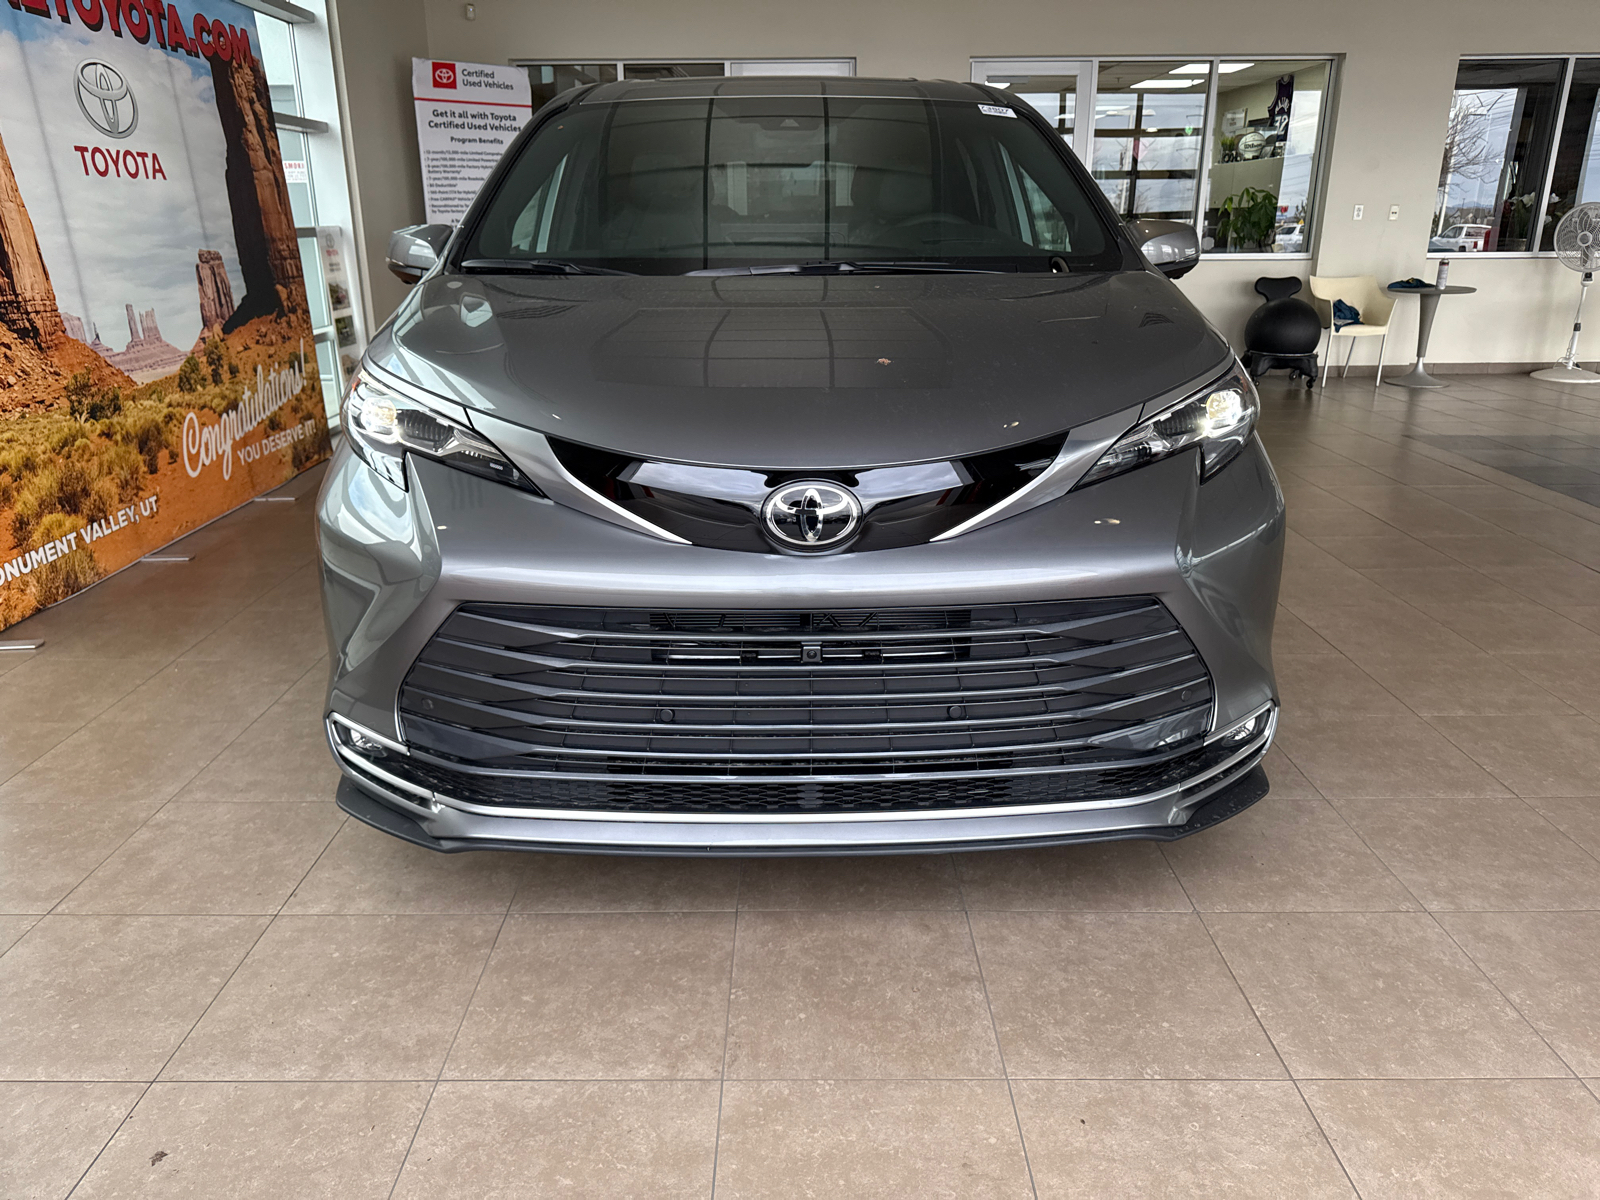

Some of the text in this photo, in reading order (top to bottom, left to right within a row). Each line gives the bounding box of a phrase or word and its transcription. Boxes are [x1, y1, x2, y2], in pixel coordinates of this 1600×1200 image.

[461, 68, 495, 79] Certified
[462, 78, 514, 91] Used Vehicles
[432, 109, 517, 123] Get it all with Toyota
[428, 120, 522, 133] Certified Used Vehicles
[450, 136, 504, 145] Program Benefits
[74, 145, 167, 180] TOYOTA
[183, 337, 307, 481] Congratulations!
[237, 418, 317, 466] YOU DESERVE IT!
[80, 504, 140, 544] VALLEY,
[139, 495, 158, 517] UT
